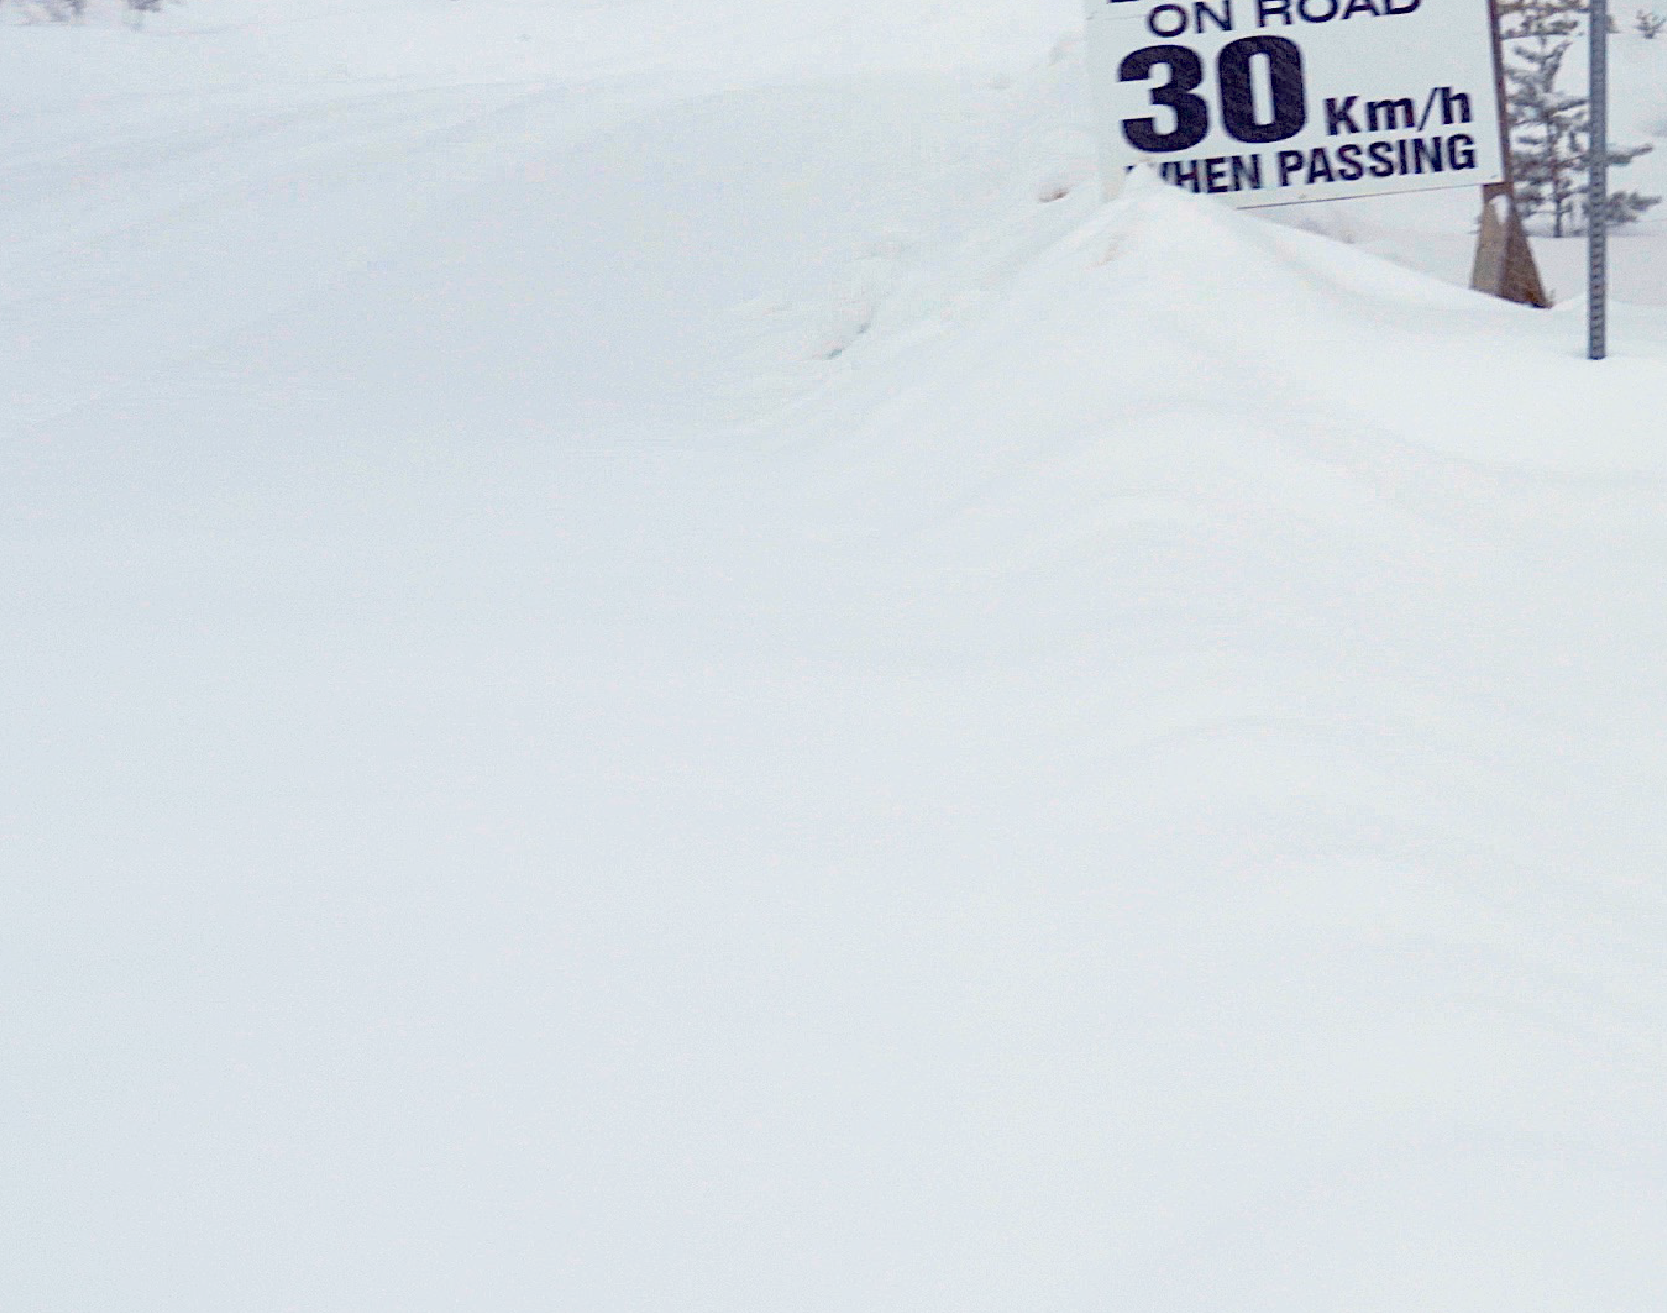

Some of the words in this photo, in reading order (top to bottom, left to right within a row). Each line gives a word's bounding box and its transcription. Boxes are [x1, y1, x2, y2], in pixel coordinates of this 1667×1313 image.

[1117, 35, 1307, 153] 30
[1324, 86, 1471, 135] Km/h
[1126, 154, 1262, 193] HEN
[1278, 134, 1477, 188] PASSING
